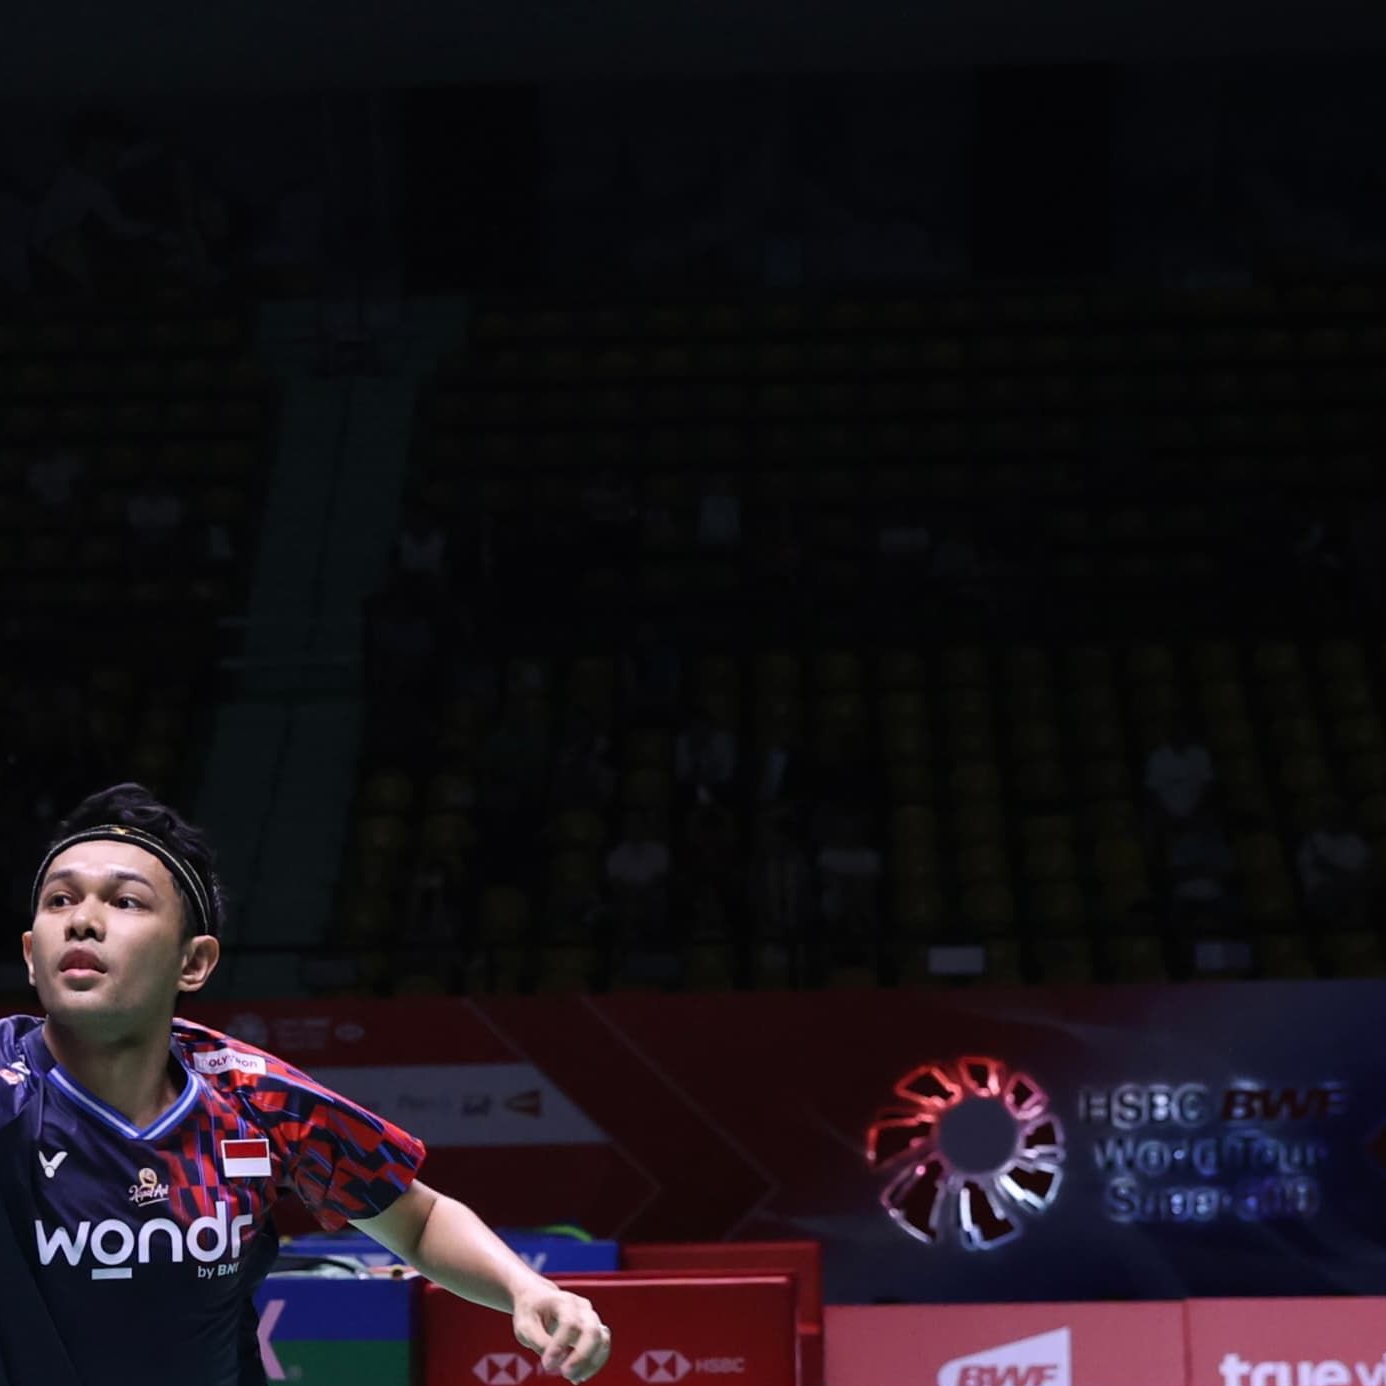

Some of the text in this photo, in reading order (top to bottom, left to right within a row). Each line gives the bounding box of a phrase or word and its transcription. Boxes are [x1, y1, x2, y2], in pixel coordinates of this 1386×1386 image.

[34, 1201, 253, 1267] wondr
[197, 1264, 214, 1280] by
[694, 1358, 745, 1373] HSBC
